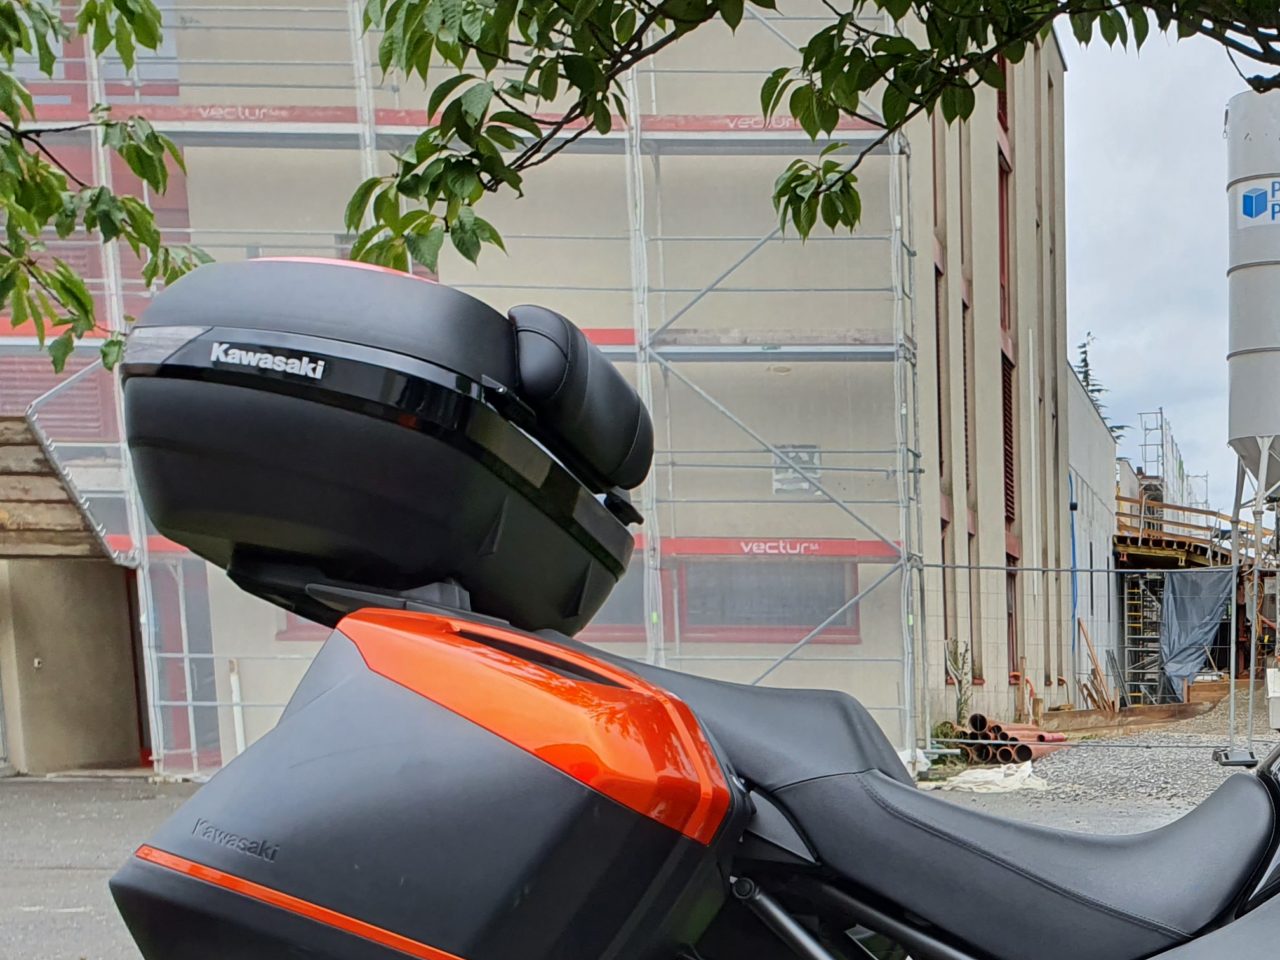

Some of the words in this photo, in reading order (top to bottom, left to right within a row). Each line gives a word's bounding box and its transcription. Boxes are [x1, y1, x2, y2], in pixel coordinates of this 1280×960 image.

[210, 341, 325, 380] Kawasaki
[740, 539, 809, 554] vectur
[192, 817, 280, 862] Kawasaki
